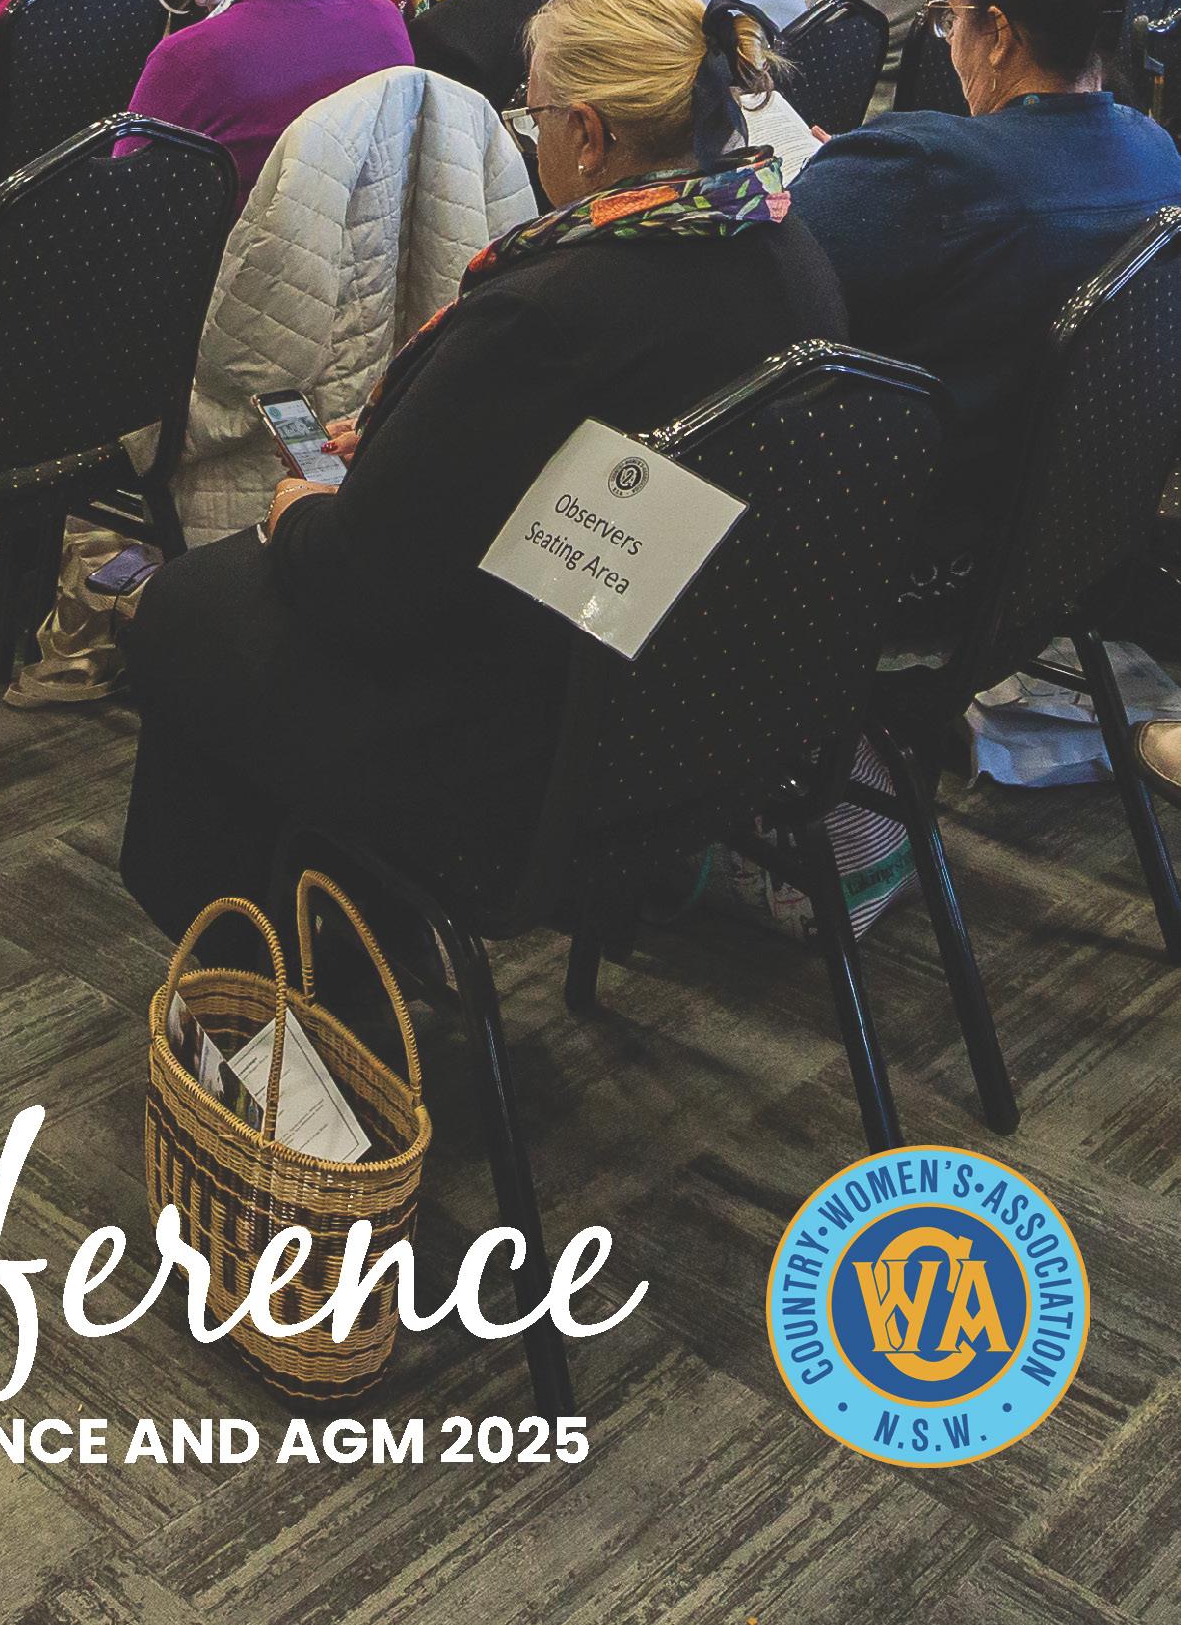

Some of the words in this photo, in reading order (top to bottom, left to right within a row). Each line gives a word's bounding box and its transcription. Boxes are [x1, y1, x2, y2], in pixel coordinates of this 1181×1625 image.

[524, 521, 585, 571] Seating
[581, 555, 630, 595] Area
[554, 493, 643, 556] Observers
